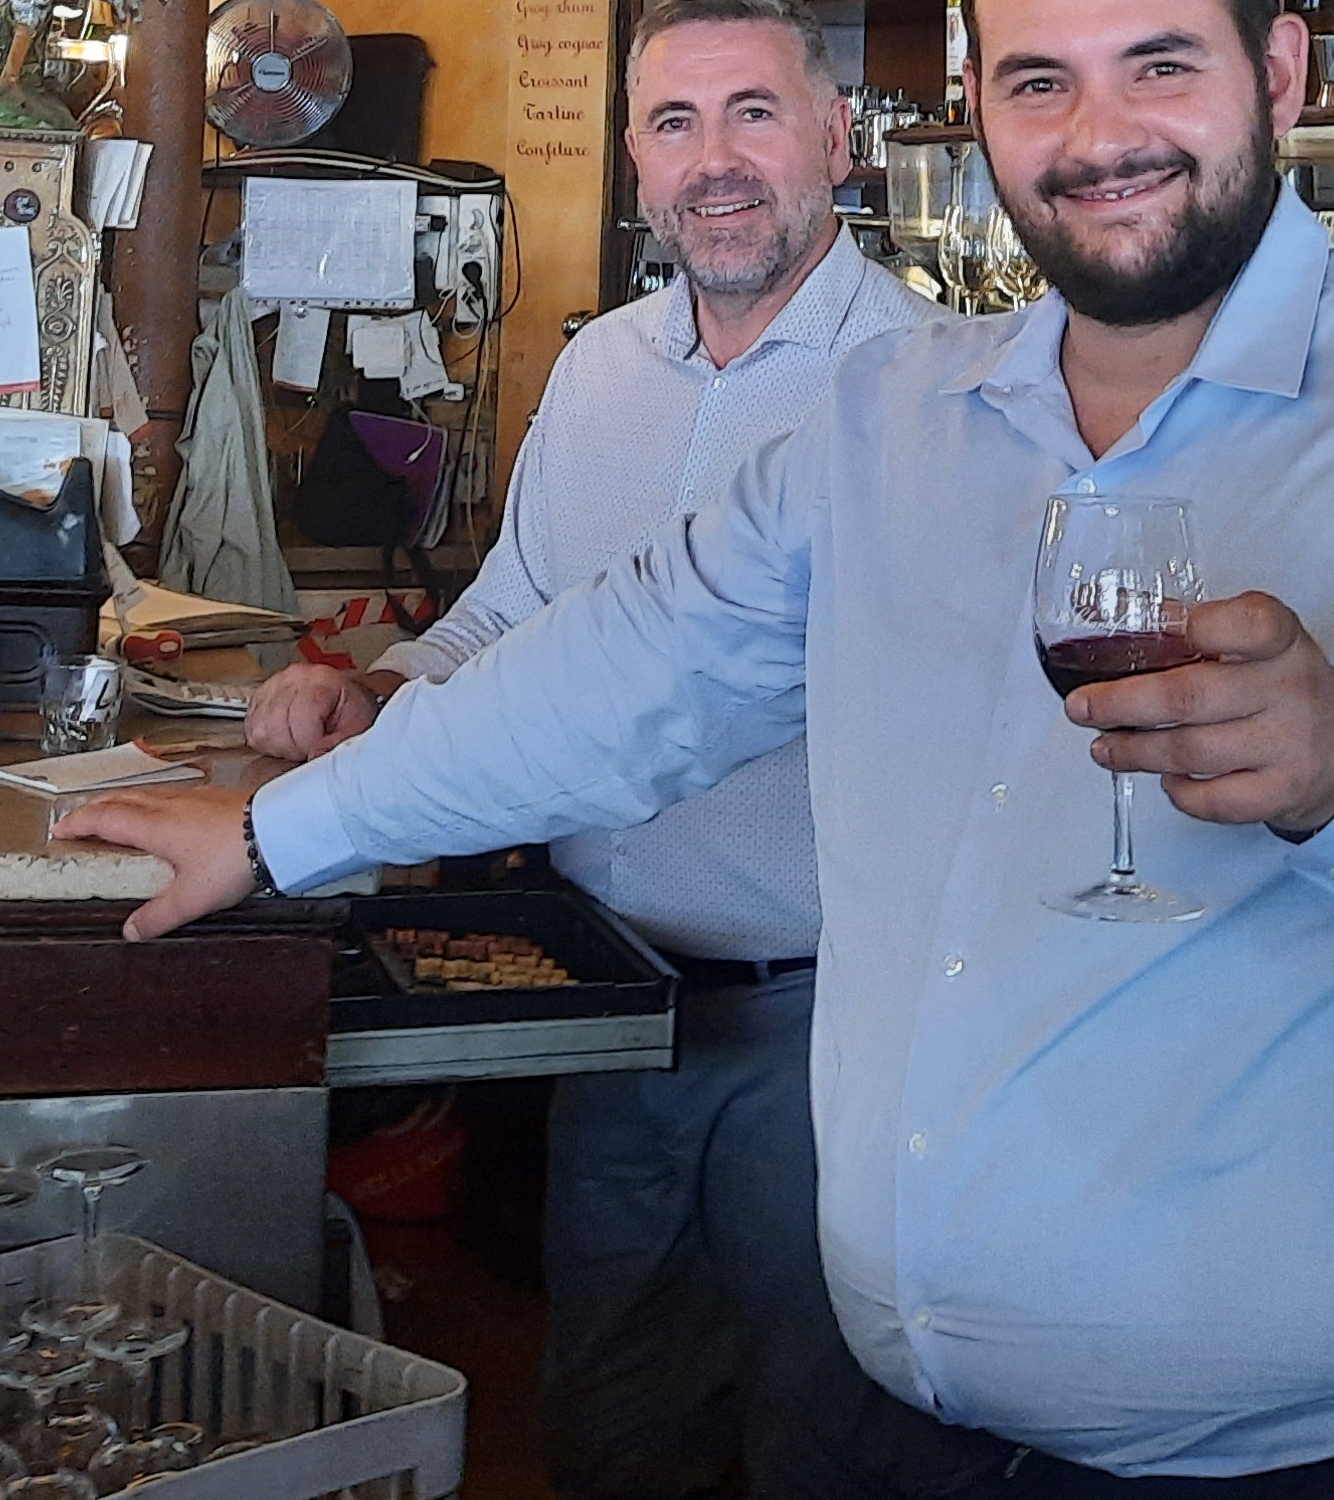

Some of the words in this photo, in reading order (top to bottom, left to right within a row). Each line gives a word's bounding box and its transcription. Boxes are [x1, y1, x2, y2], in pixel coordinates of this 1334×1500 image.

[519, 70, 588, 88] Croissant
[523, 102, 585, 121] Tartine
[517, 139, 589, 166] Confiture
